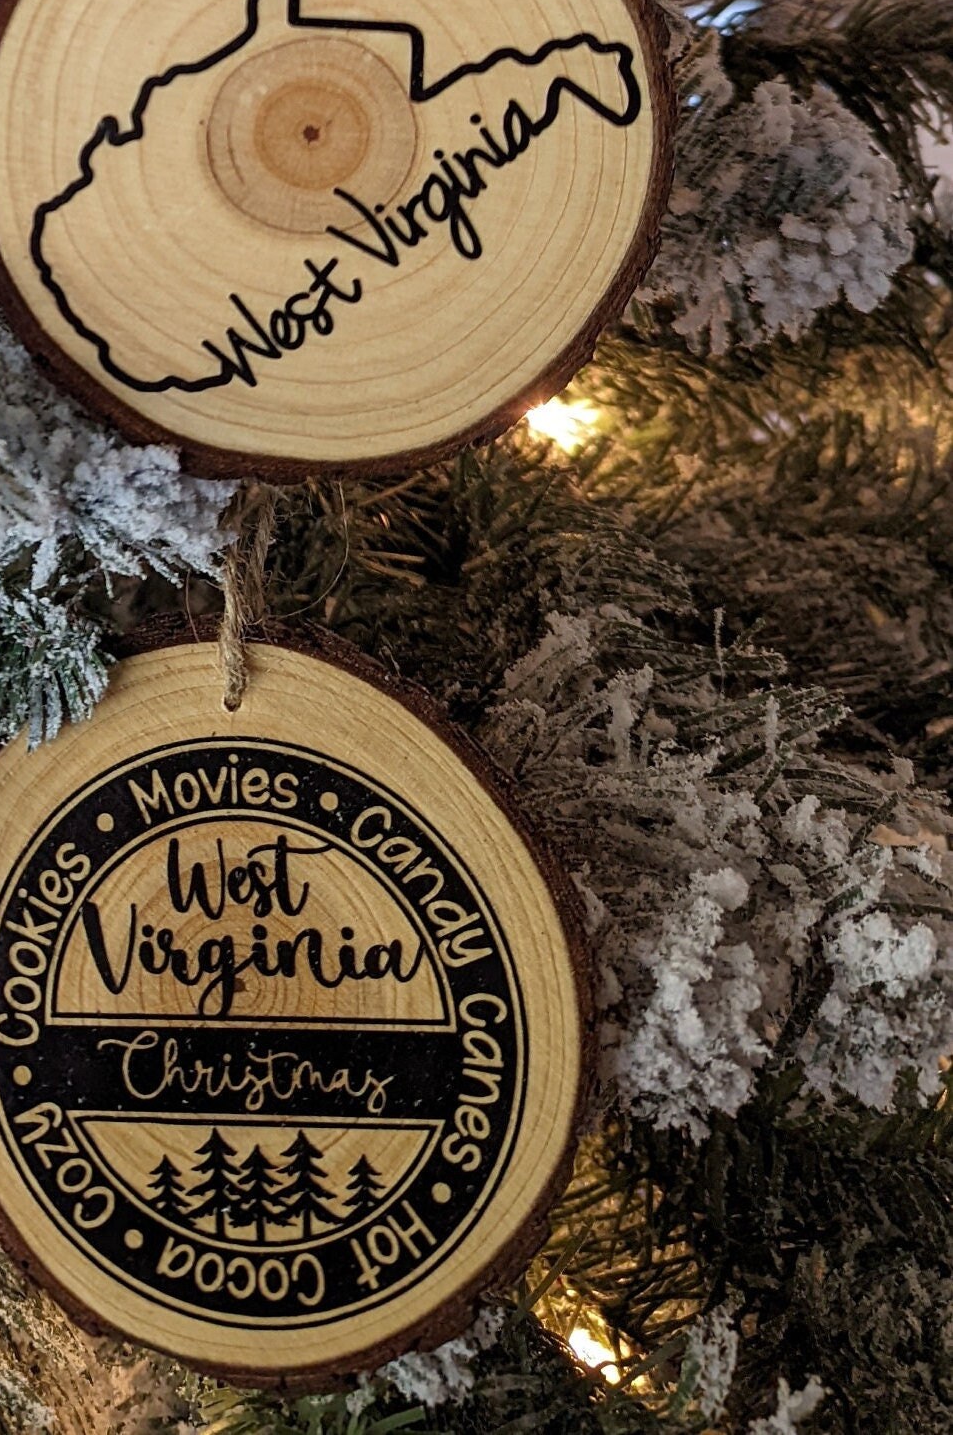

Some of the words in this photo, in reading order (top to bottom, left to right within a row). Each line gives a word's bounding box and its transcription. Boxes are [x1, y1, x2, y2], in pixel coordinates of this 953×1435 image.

[202, 258, 362, 387] West
[327, 99, 542, 267] Virginia
[128, 753, 299, 825] Movies
[167, 834, 332, 918] West
[81, 901, 425, 1017] Virginia
[352, 805, 493, 968] Candy
[442, 993, 508, 1173] Canes
[97, 1030, 395, 1114] Christmas
[13, 1100, 116, 1230] Cozy
[157, 1238, 326, 1306] Cocoa
[350, 1200, 438, 1289] Hot
